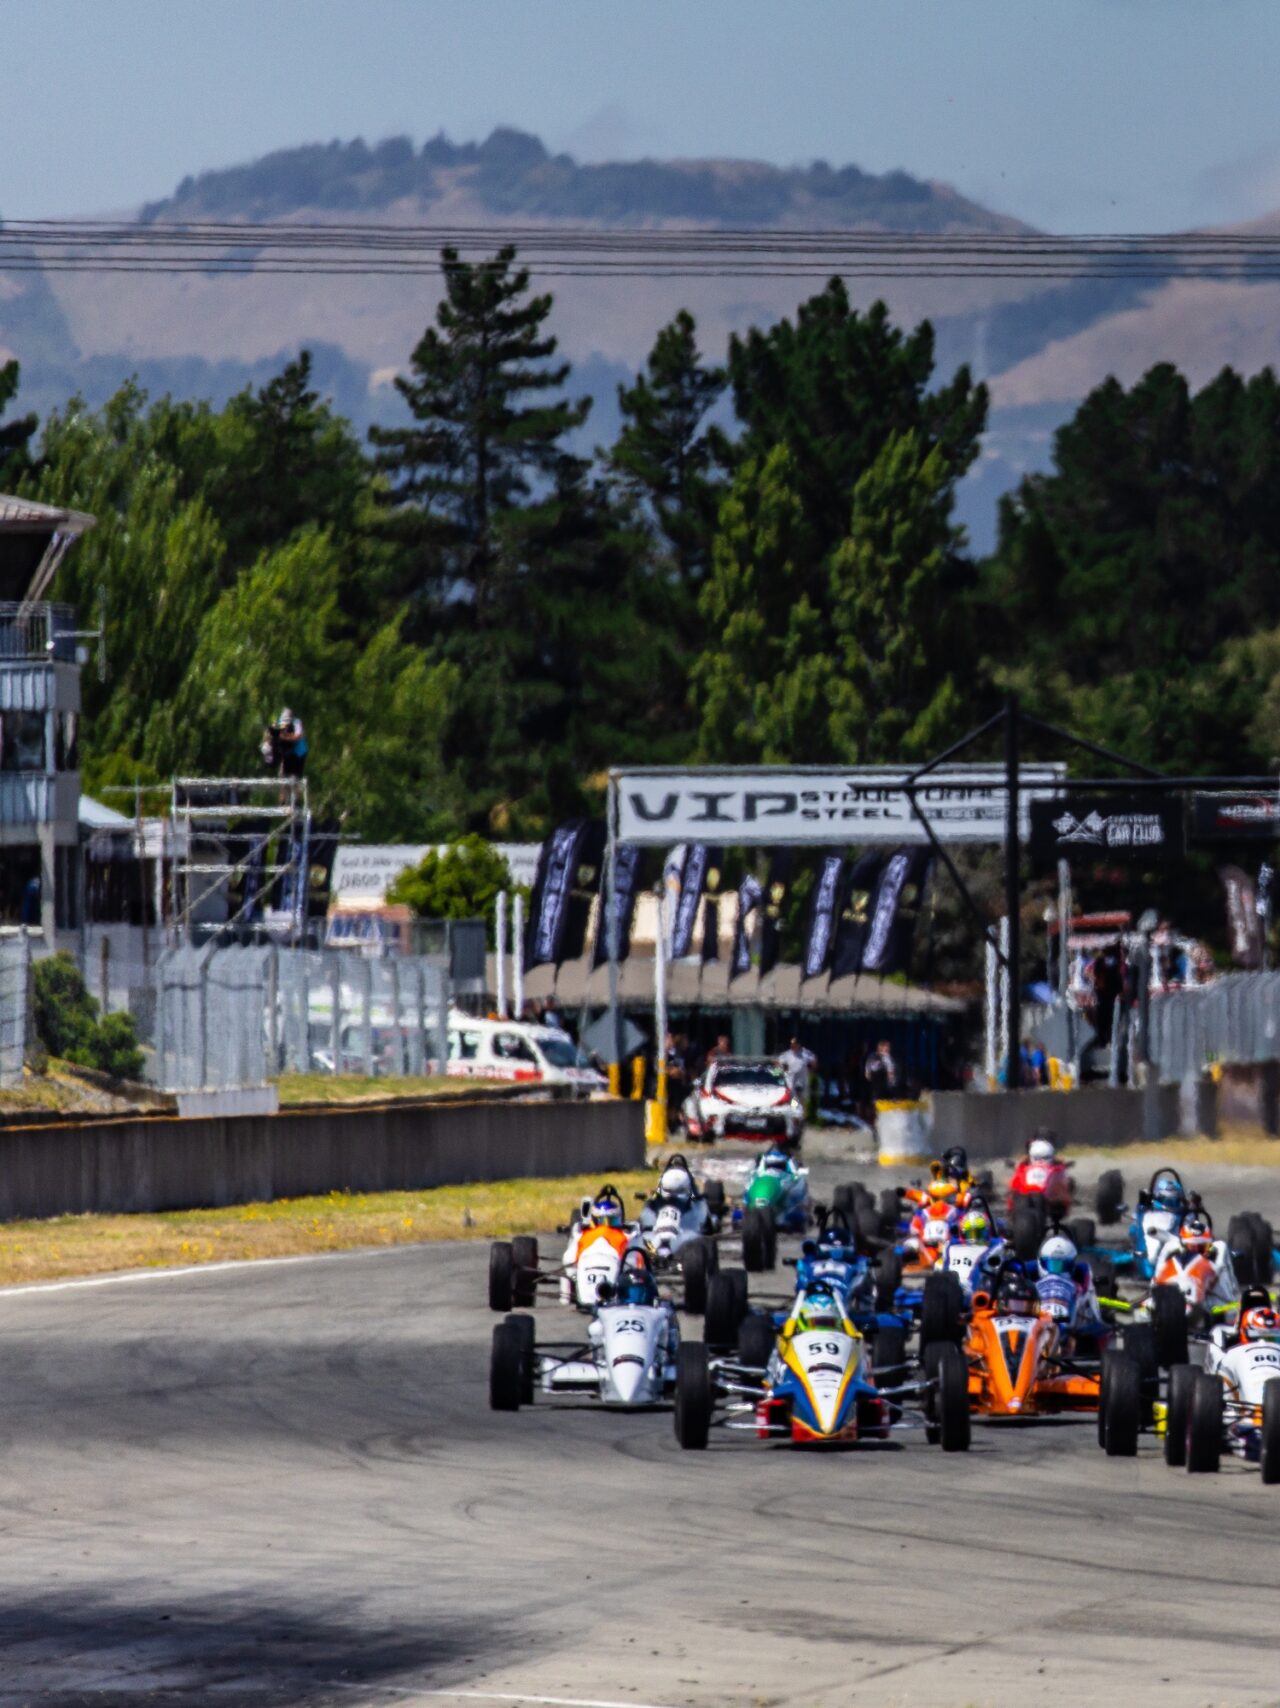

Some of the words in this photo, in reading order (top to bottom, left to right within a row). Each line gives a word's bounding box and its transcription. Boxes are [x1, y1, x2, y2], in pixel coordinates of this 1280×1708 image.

[801, 789, 1006, 802] STRUCURAL
[629, 791, 798, 822] VIP
[801, 808, 902, 820] STEEL
[616, 1320, 645, 1333] 25
[808, 1342, 839, 1356] 59
